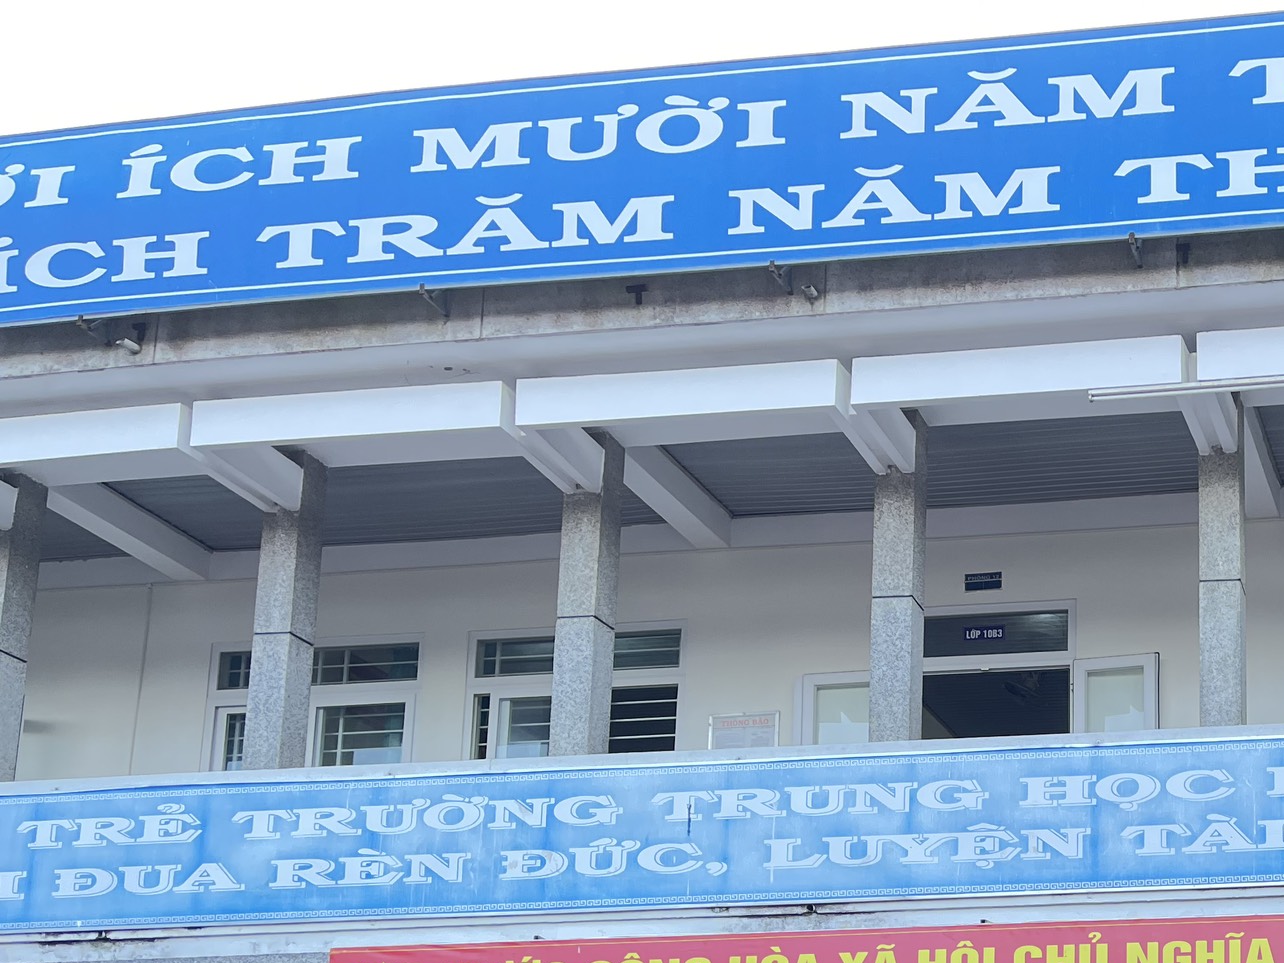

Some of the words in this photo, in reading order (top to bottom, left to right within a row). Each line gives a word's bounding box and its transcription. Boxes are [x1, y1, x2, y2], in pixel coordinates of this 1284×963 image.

[117, 136, 363, 199] ÍCH
[410, 95, 787, 173] MƯỜI
[840, 67, 1175, 139] NĂM
[256, 194, 675, 269] TRĂM
[727, 165, 1061, 235] NĂM
[966, 629, 981, 640] LỚP
[983, 628, 1003, 639] 10B3
[17, 803, 203, 849] TRẺ
[231, 794, 623, 841] TRƯỜNG
[651, 779, 990, 823] TRUNG
[1018, 769, 1237, 812] HỌC
[52, 862, 246, 898] ĐUA
[268, 849, 472, 890] RÈN
[498, 838, 728, 881] ĐỨC,
[763, 823, 1092, 870] LUYỆN
